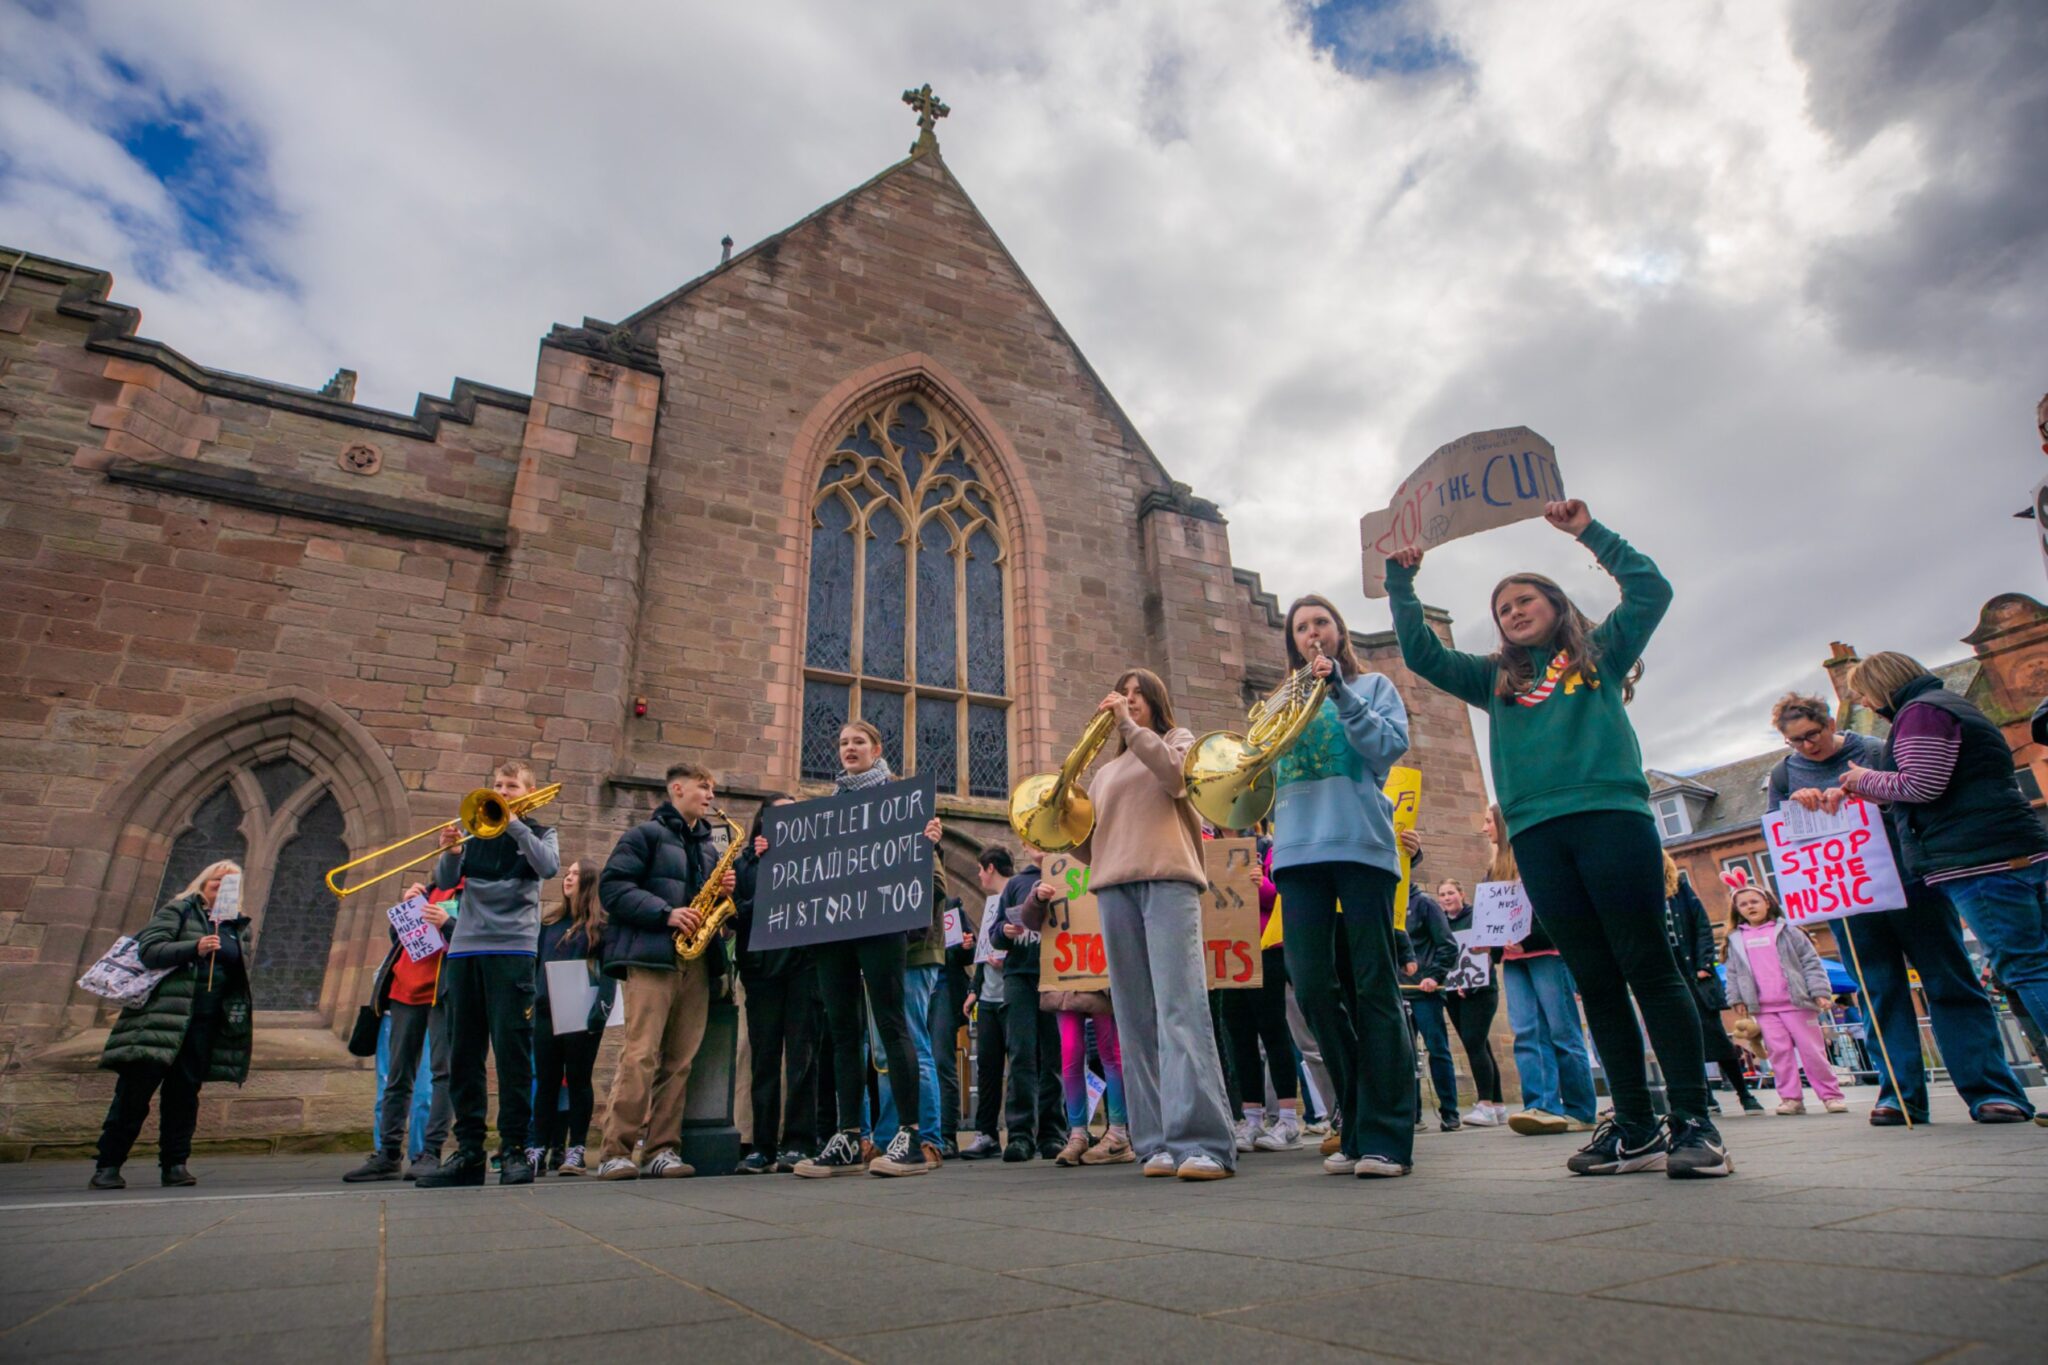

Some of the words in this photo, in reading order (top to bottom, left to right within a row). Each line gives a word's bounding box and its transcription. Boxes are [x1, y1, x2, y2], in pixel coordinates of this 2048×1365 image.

[1435, 472, 1477, 507] THE
[839, 801, 874, 835] LET
[880, 789, 925, 824] OUR
[772, 847, 842, 890] DREAM
[847, 831, 924, 876] BECOME
[1781, 829, 1871, 875] STOP
[1802, 856, 1867, 885] THE
[877, 876, 924, 914] TOO
[1489, 884, 1517, 899] SAVE
[1784, 876, 1874, 920] MUSIC
[388, 899, 416, 919] SAVE
[392, 911, 412, 926] THE
[397, 916, 426, 934] MUSIC
[400, 924, 429, 944] STOP
[1486, 924, 1505, 934] THE
[405, 936, 428, 952] THE
[411, 943, 435, 960] CUTS
[1053, 931, 1108, 975] STO
[1204, 939, 1254, 983] TS
